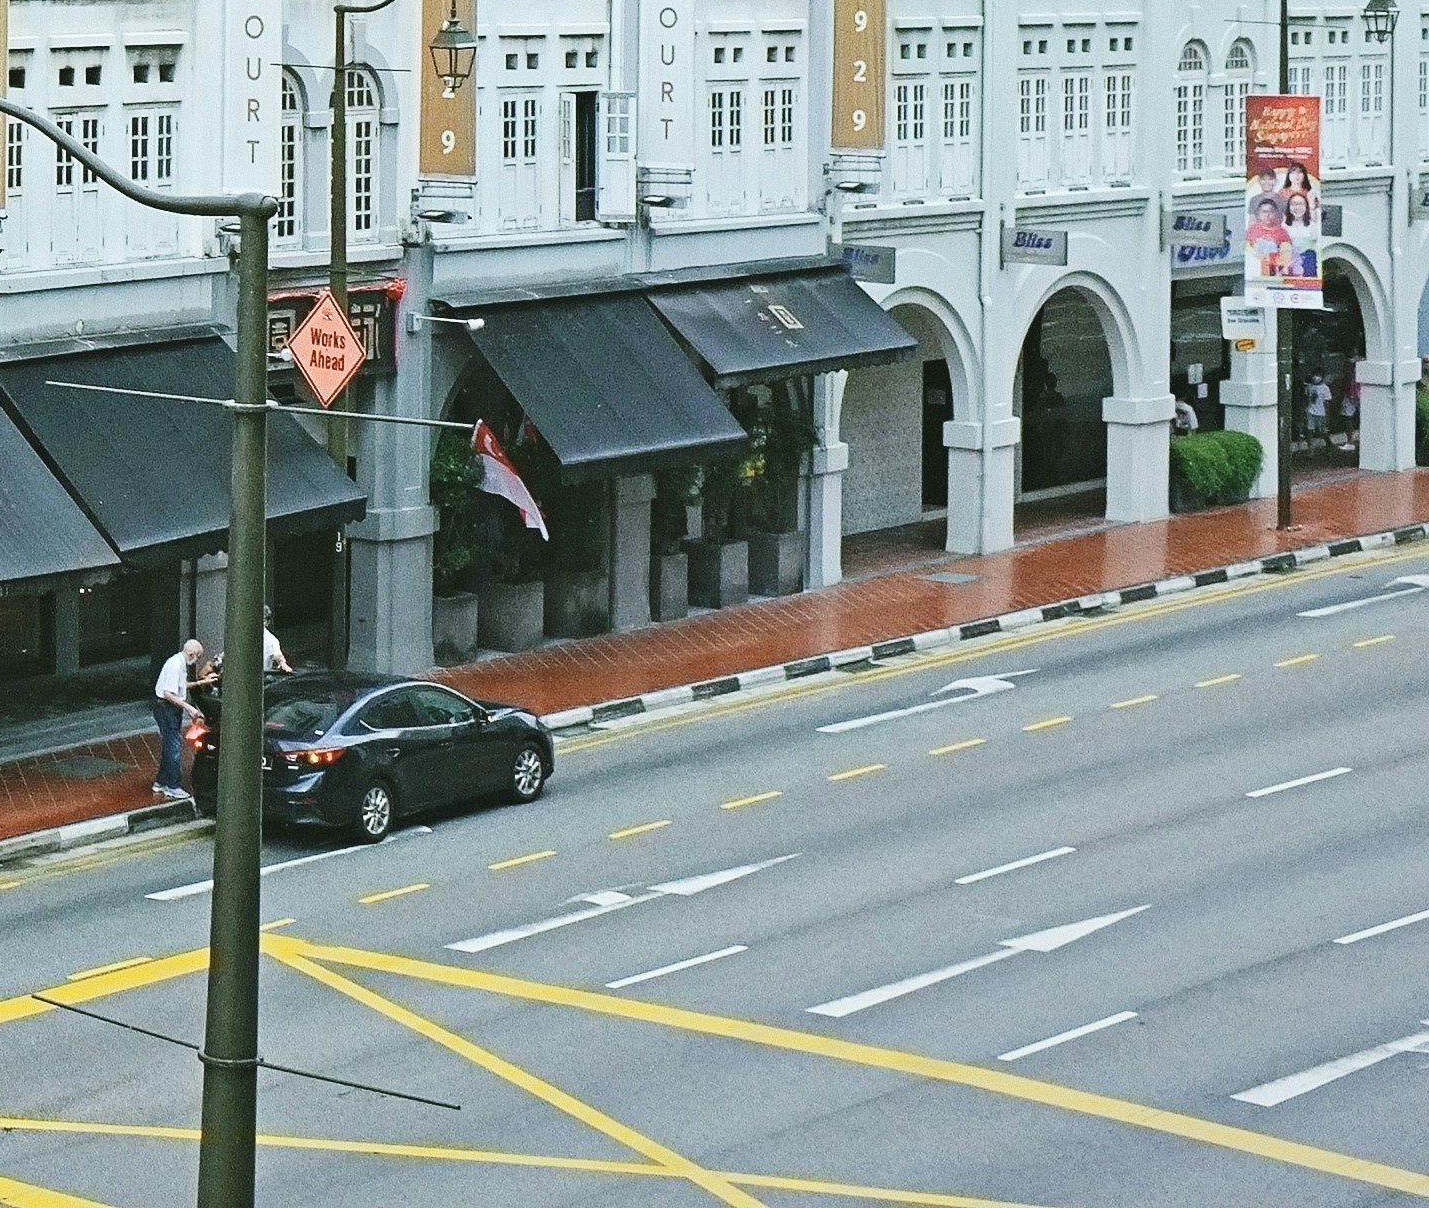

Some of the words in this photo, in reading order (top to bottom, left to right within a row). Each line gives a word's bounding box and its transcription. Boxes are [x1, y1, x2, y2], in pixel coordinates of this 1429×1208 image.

[1013, 231, 1053, 250] Bliss
[310, 327, 346, 350] Works
[309, 350, 345, 372] Ahead
